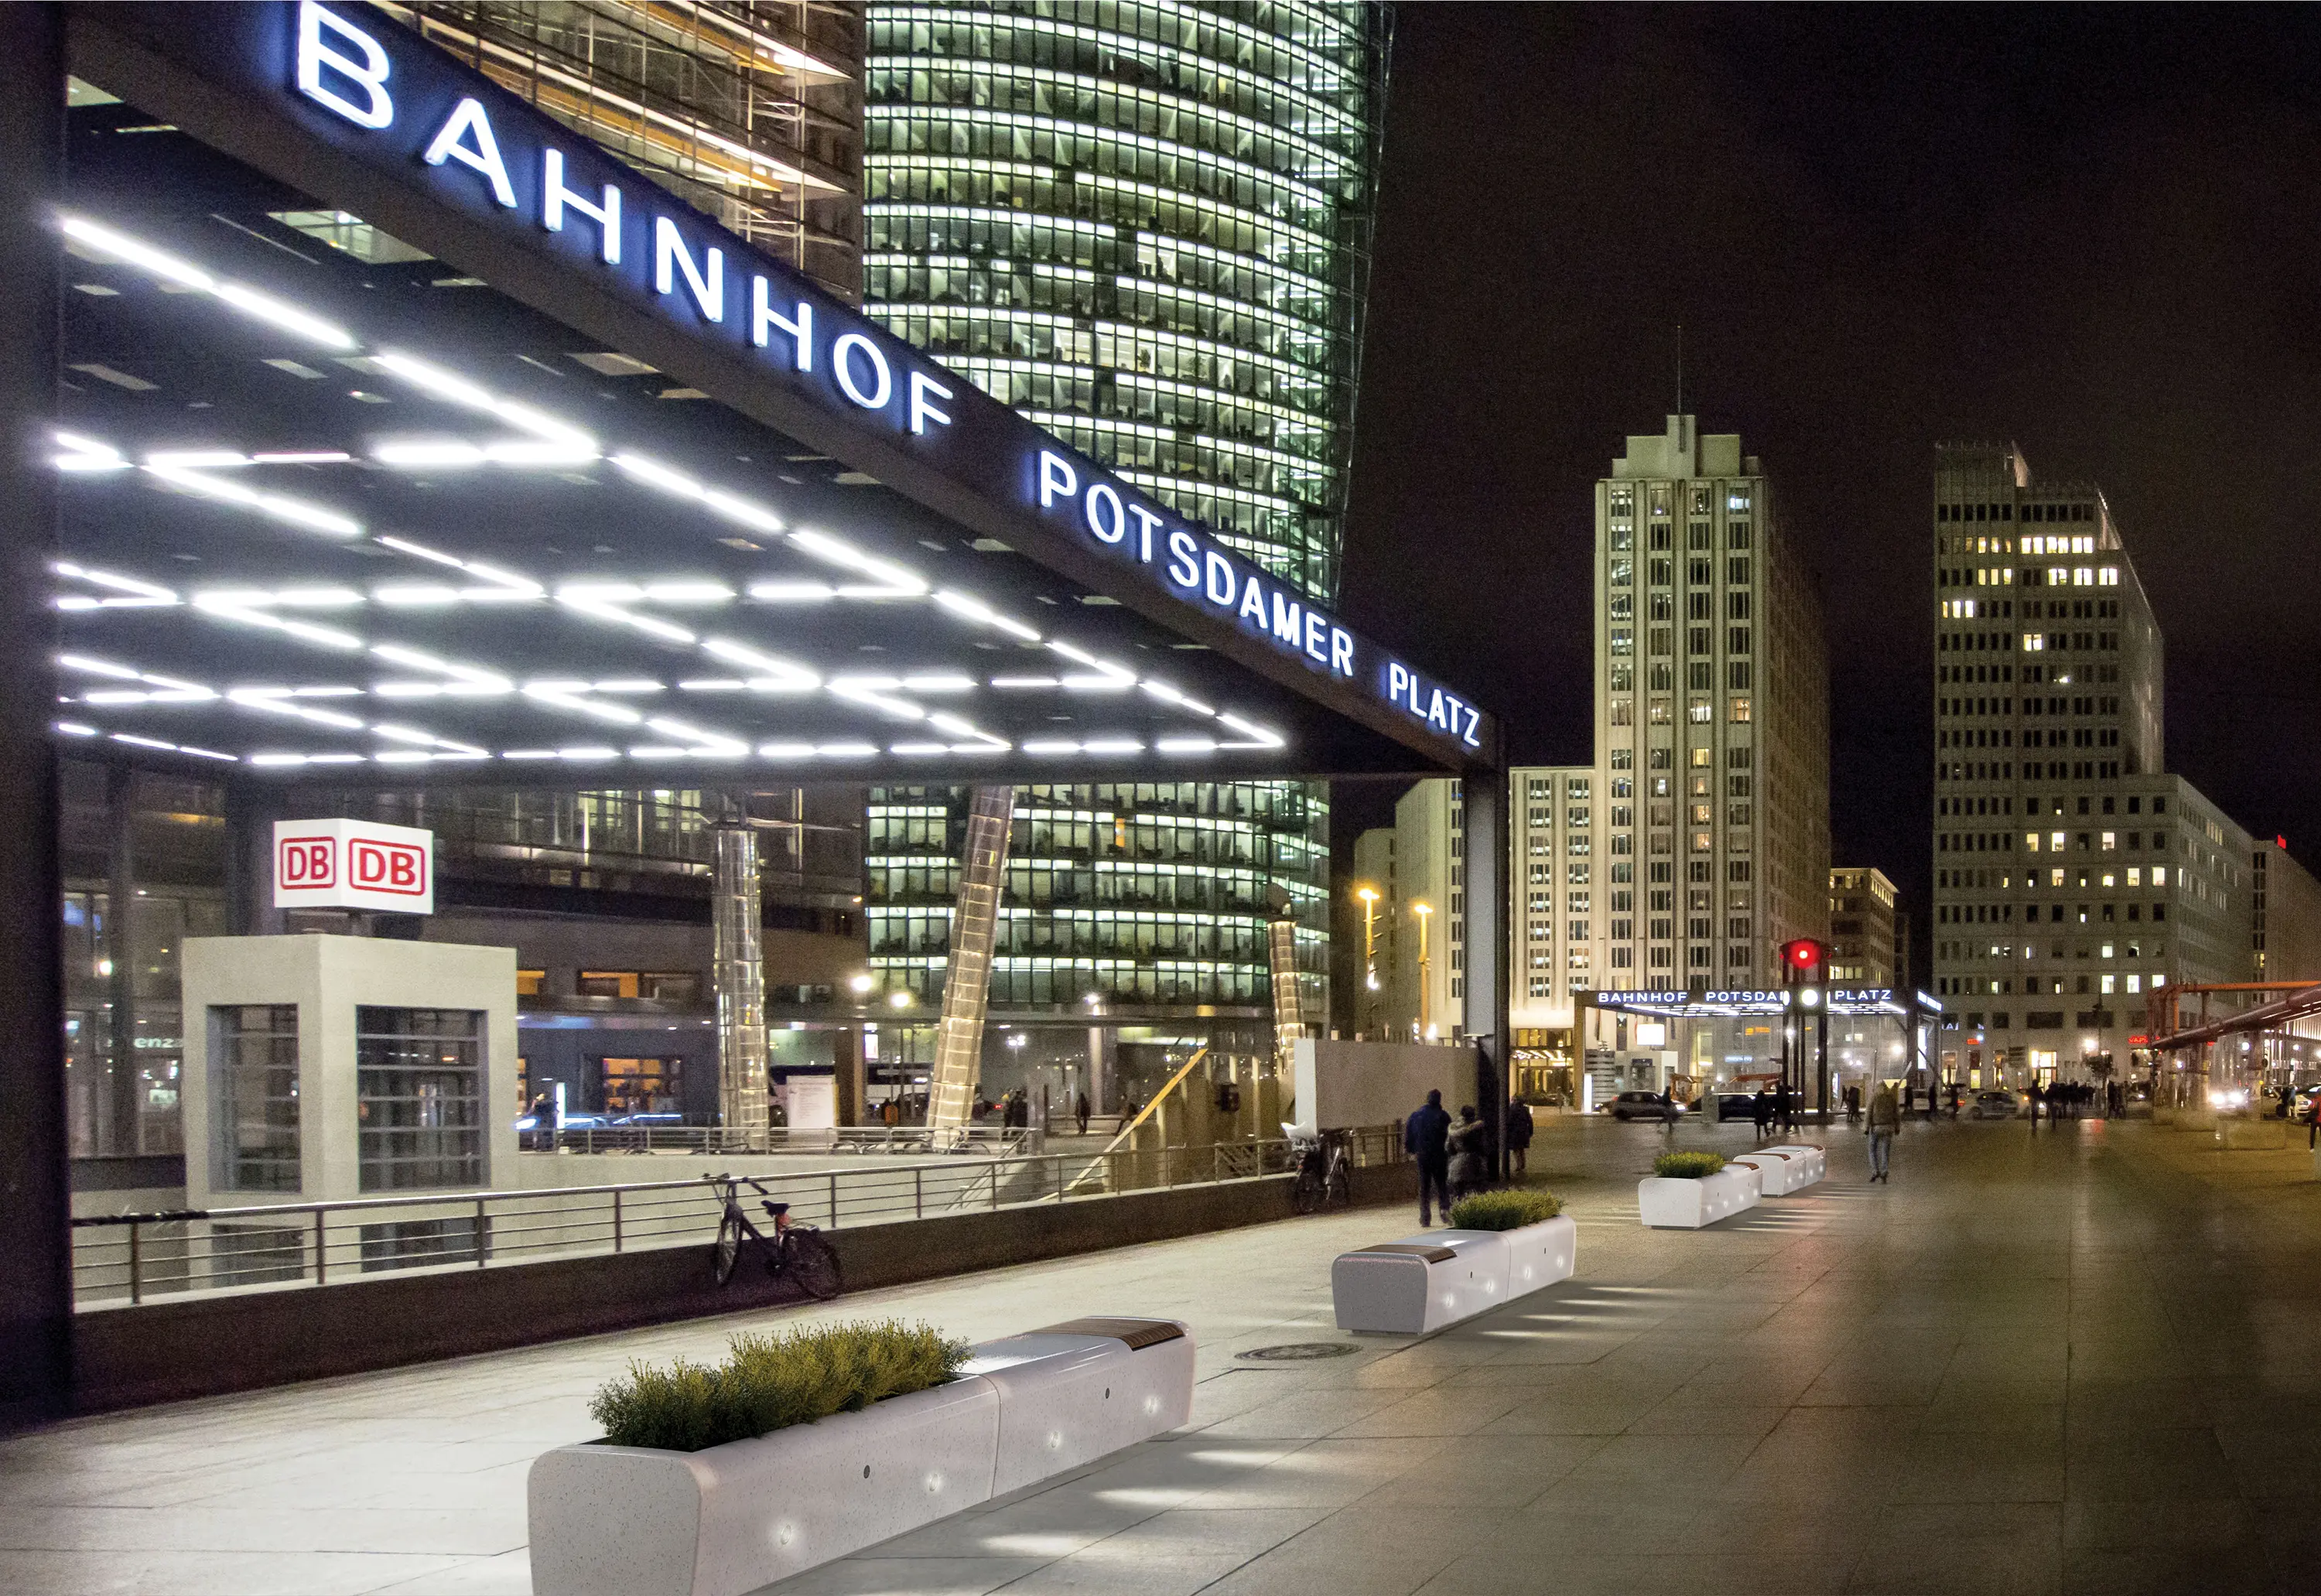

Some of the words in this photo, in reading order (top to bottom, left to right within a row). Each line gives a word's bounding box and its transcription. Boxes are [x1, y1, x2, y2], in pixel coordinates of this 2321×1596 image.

[297, 1, 953, 436] BAHNHOF
[1039, 449, 1354, 676] POTSDAMER
[1389, 662, 1480, 747] PLATZ
[287, 845, 330, 880] DB
[359, 847, 416, 886] DB
[1598, 991, 1688, 1003] BAHNHOF
[1704, 990, 1784, 1003] POTSDA
[1834, 989, 1892, 1001] PLATZ
